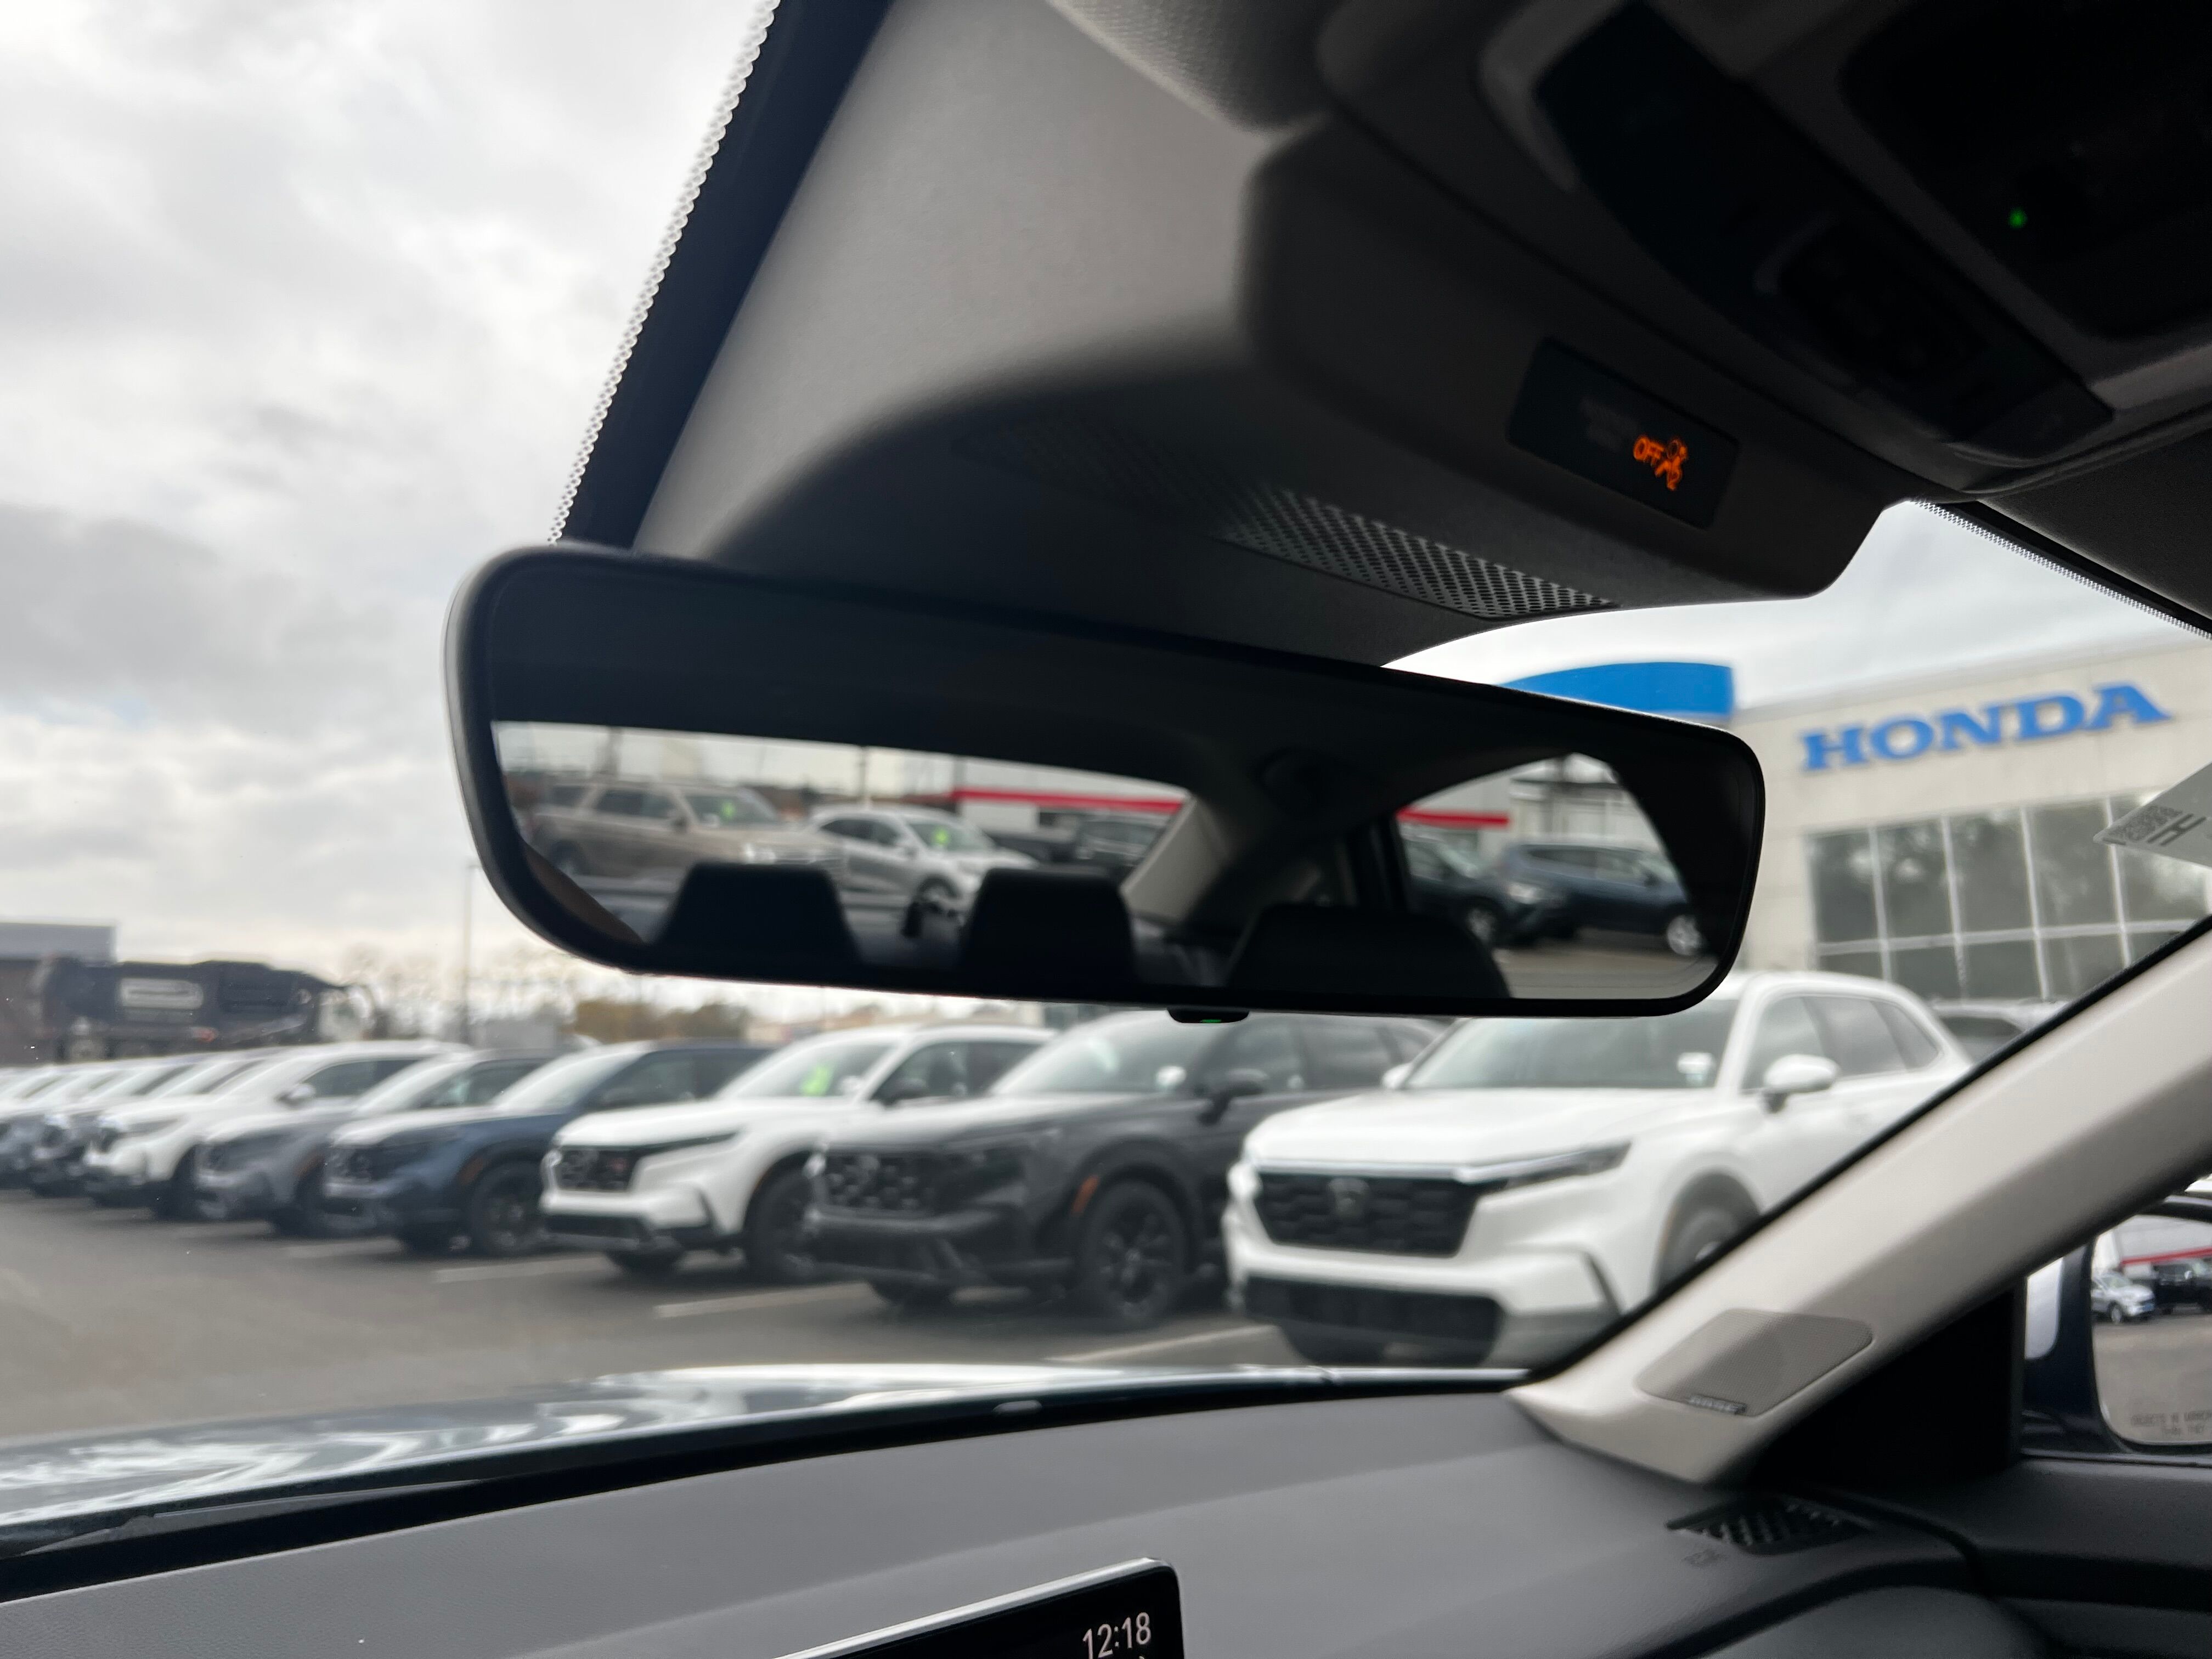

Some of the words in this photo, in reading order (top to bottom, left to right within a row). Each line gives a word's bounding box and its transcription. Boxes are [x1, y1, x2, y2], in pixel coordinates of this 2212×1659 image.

[1634, 436, 1664, 466] OFF
[1801, 683, 2171, 770] HONDA
[1082, 1612, 1152, 1659] 12:18
